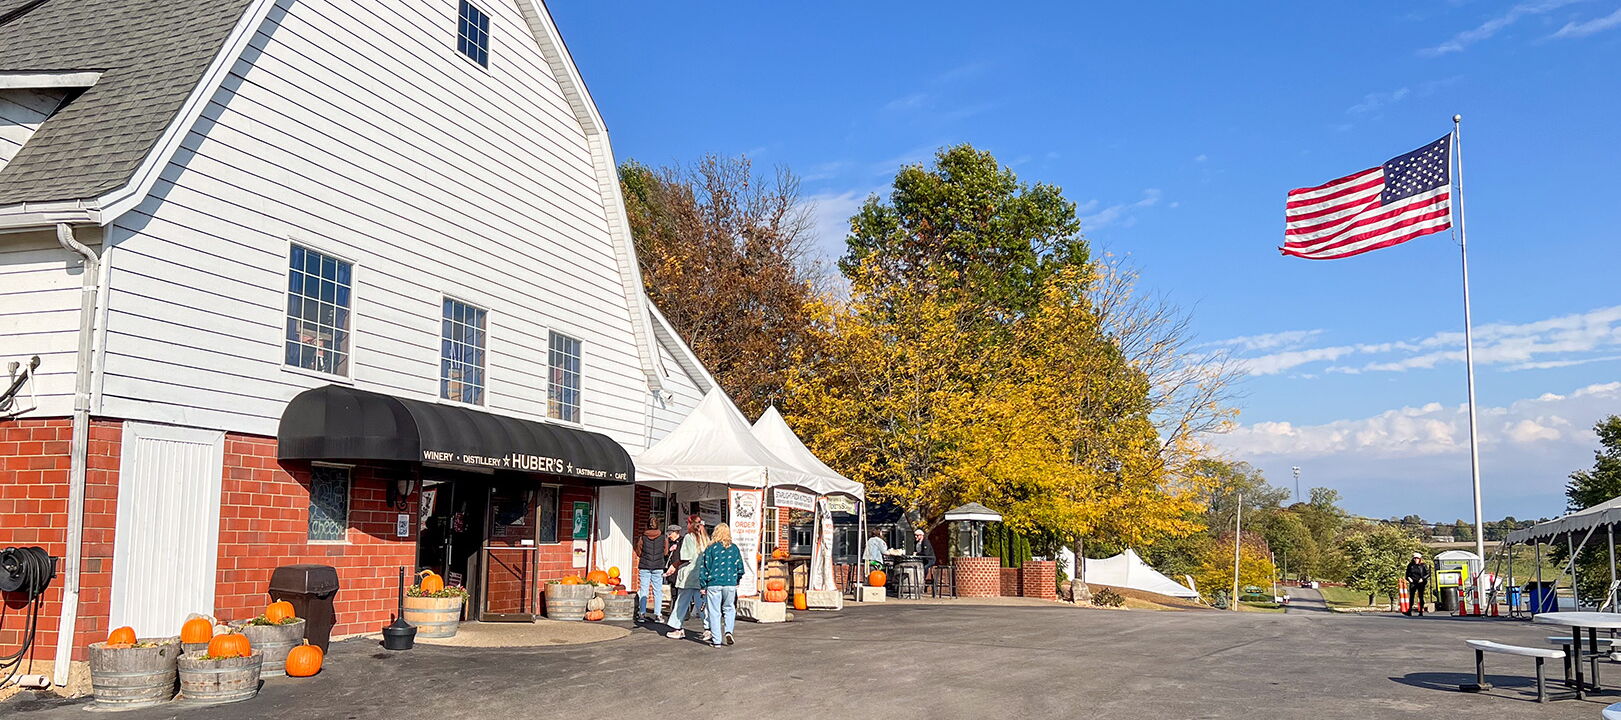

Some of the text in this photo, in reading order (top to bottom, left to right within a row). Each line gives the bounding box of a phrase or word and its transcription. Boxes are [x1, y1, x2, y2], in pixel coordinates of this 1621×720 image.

[423, 450, 454, 461] WINERY
[463, 454, 501, 466] DISTILLERY
[511, 453, 564, 473] HUBER'S
[576, 467, 595, 477] TASTING
[595, 470, 607, 478] LOFT
